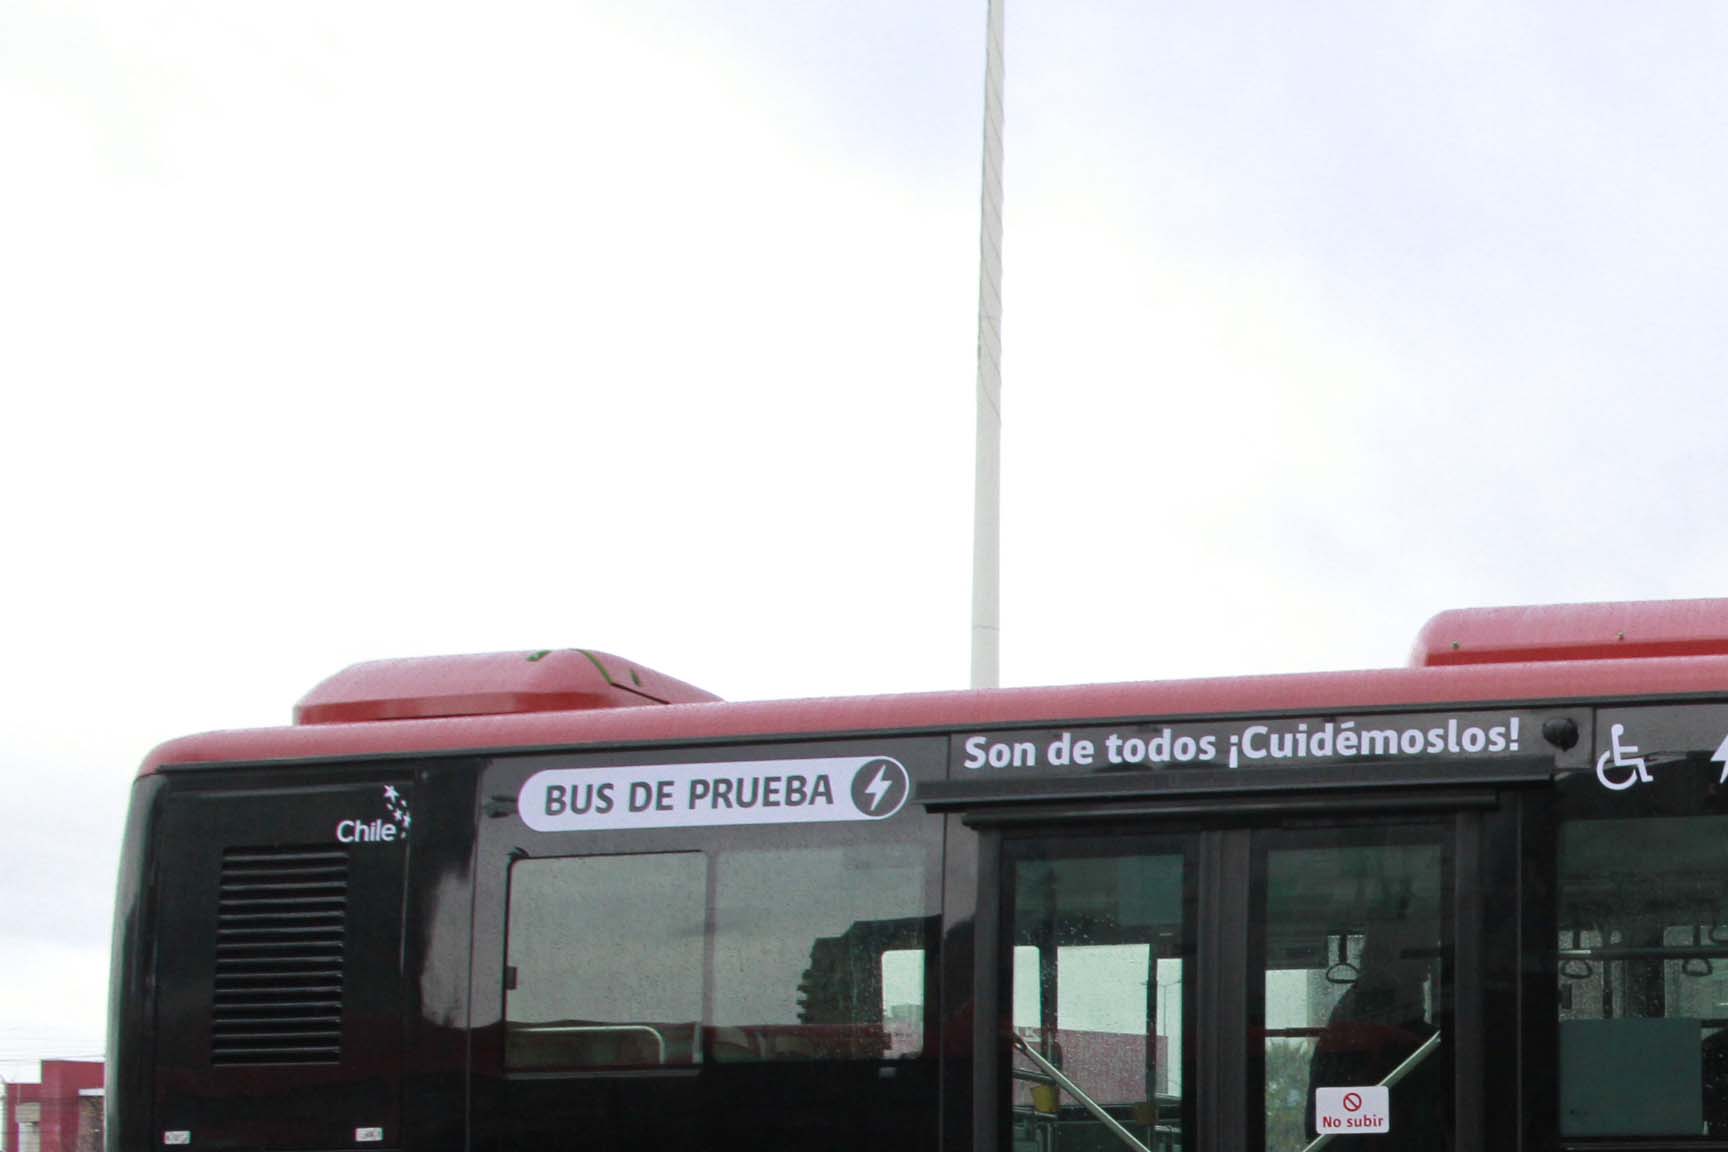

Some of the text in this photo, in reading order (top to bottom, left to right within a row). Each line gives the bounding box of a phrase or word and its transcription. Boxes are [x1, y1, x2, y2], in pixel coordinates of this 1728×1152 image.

[963, 716, 1520, 769] Son de todos ¡Cuidémoslos!
[544, 773, 835, 817] BUS DE PRUEBA
[336, 819, 397, 843] Chile
[1322, 1114, 1384, 1128] No subir
